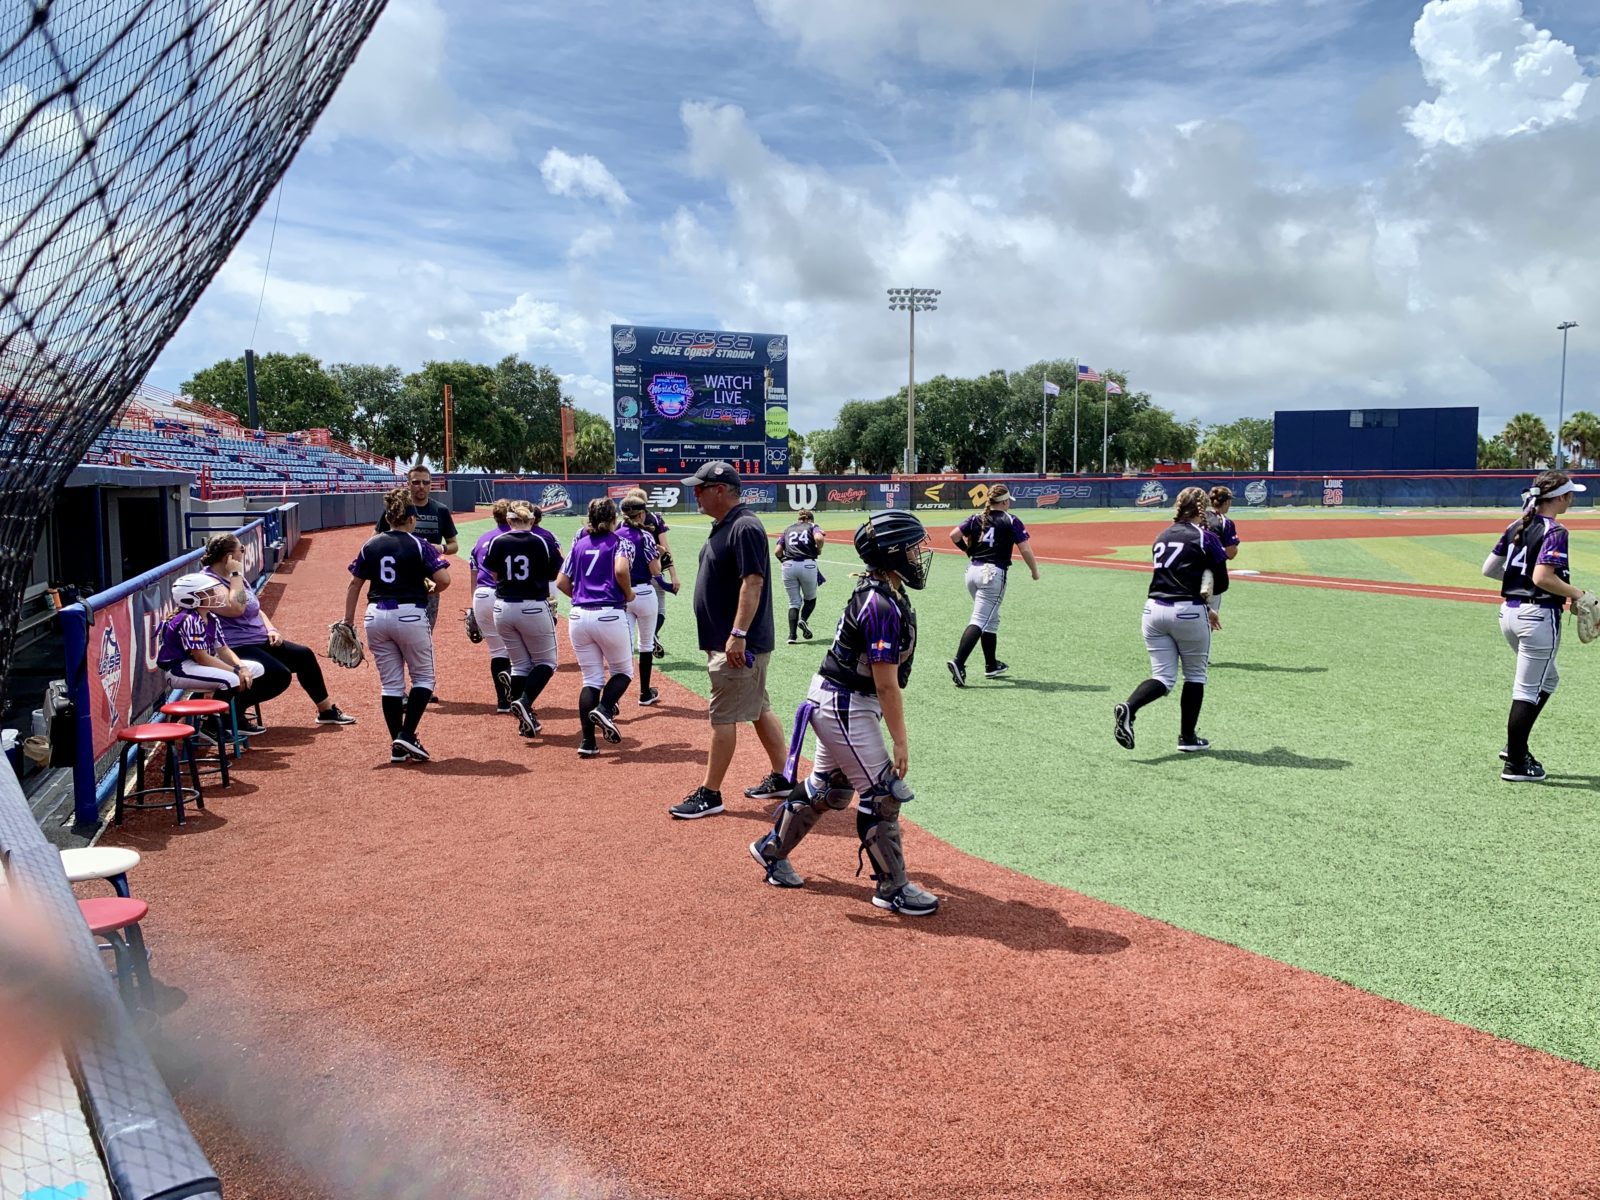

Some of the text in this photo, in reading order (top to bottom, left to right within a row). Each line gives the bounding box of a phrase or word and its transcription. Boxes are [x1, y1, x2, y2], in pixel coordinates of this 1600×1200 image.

[651, 345, 681, 356] SPACE
[684, 348, 715, 357] COAST
[716, 349, 756, 360] STADIUM
[703, 374, 752, 390] WATCH
[714, 390, 742, 404] LIVE
[735, 417, 747, 425] LIVE
[879, 483, 900, 493] WILLIS
[1323, 479, 1343, 488] LOWE
[827, 487, 867, 503] Rawlings
[1322, 488, 1344, 505] 26
[788, 529, 809, 546] 24
[1153, 541, 1185, 568] 27
[1502, 542, 1528, 576] 14
[380, 555, 396, 583] 6
[504, 554, 530, 581] 13
[585, 549, 600, 577] 7
